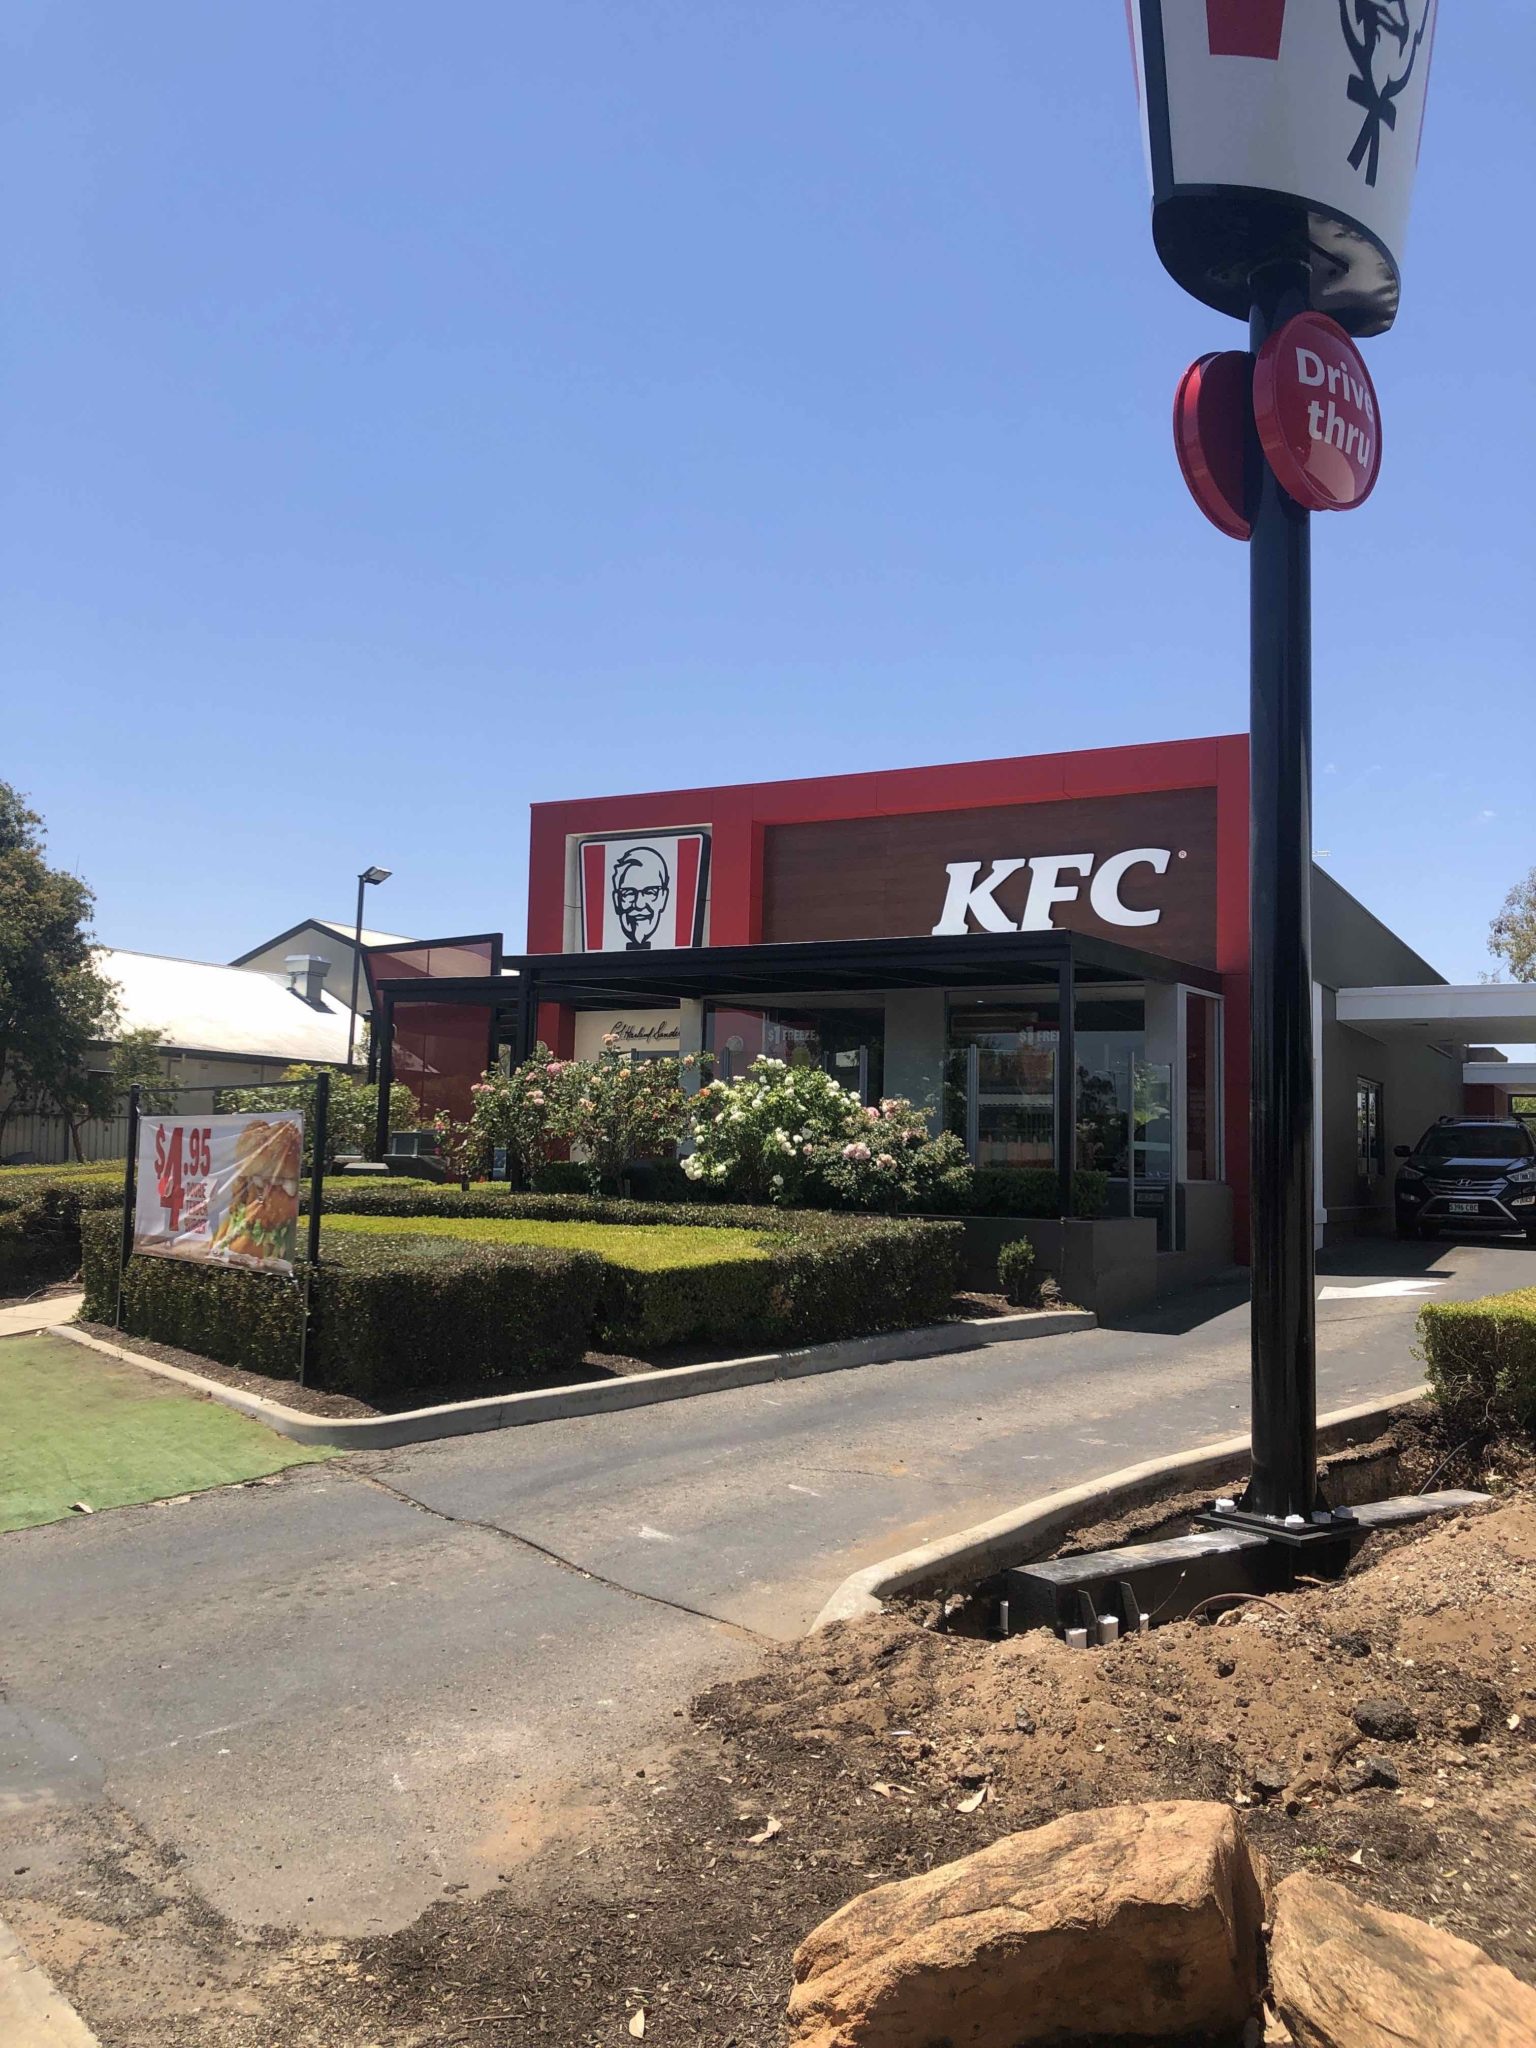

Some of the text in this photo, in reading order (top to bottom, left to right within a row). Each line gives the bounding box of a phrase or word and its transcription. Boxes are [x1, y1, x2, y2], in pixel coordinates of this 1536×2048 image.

[1296, 347, 1374, 422] Drive
[1308, 400, 1370, 468] thru
[932, 848, 1171, 935] KFC
[782, 1029, 816, 1041] FREEZE
[154, 1123, 212, 1232] $4.95
